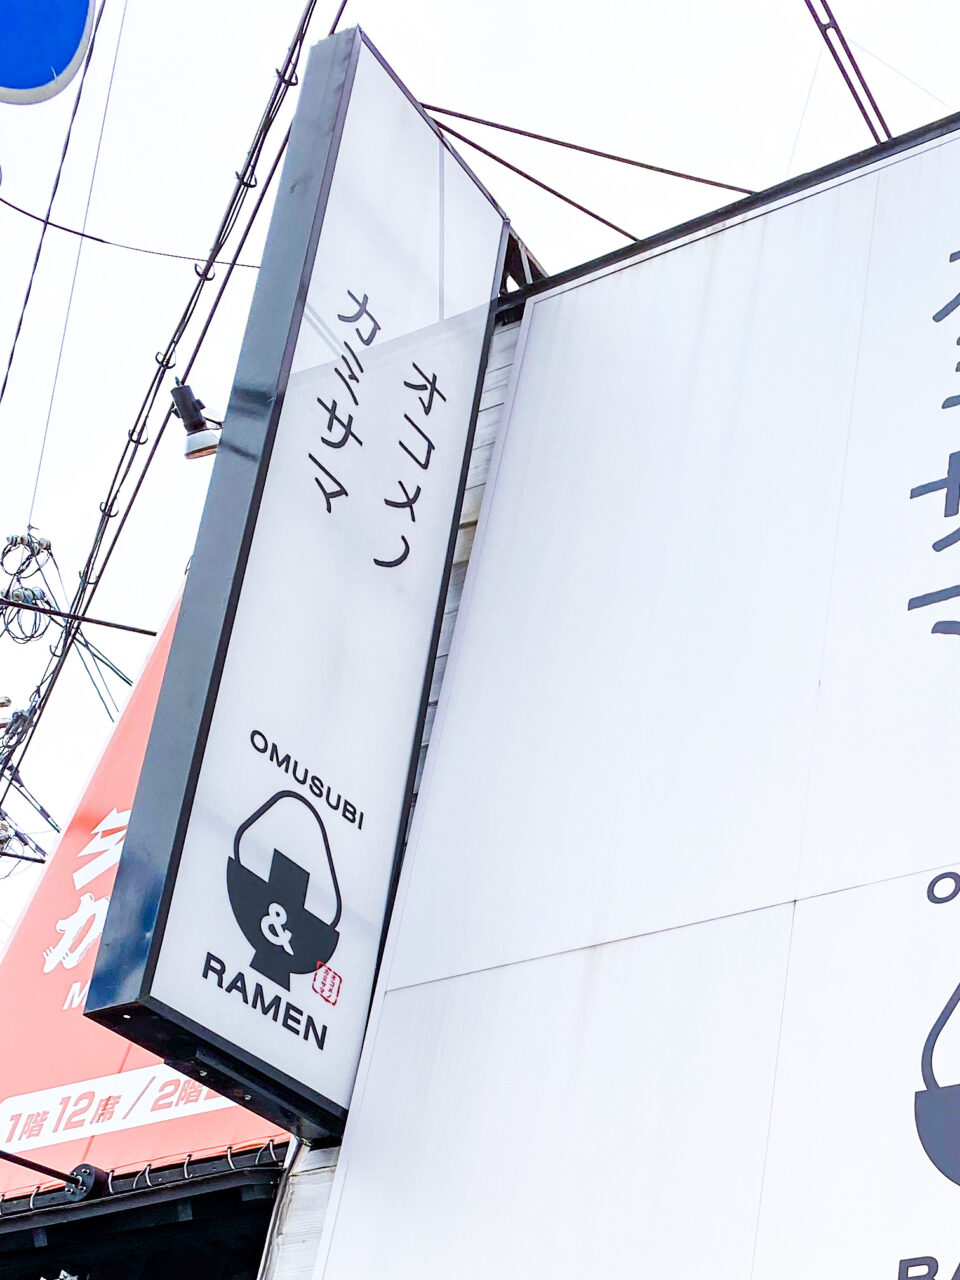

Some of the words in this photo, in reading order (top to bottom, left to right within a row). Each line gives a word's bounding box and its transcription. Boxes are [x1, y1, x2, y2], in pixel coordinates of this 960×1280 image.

[307, 289, 383, 514] カミサマ
[372, 361, 447, 570] オコメノ
[249, 728, 365, 831] OMUSUBI
[259, 902, 294, 956] &
[201, 951, 328, 1051] RAMEN
